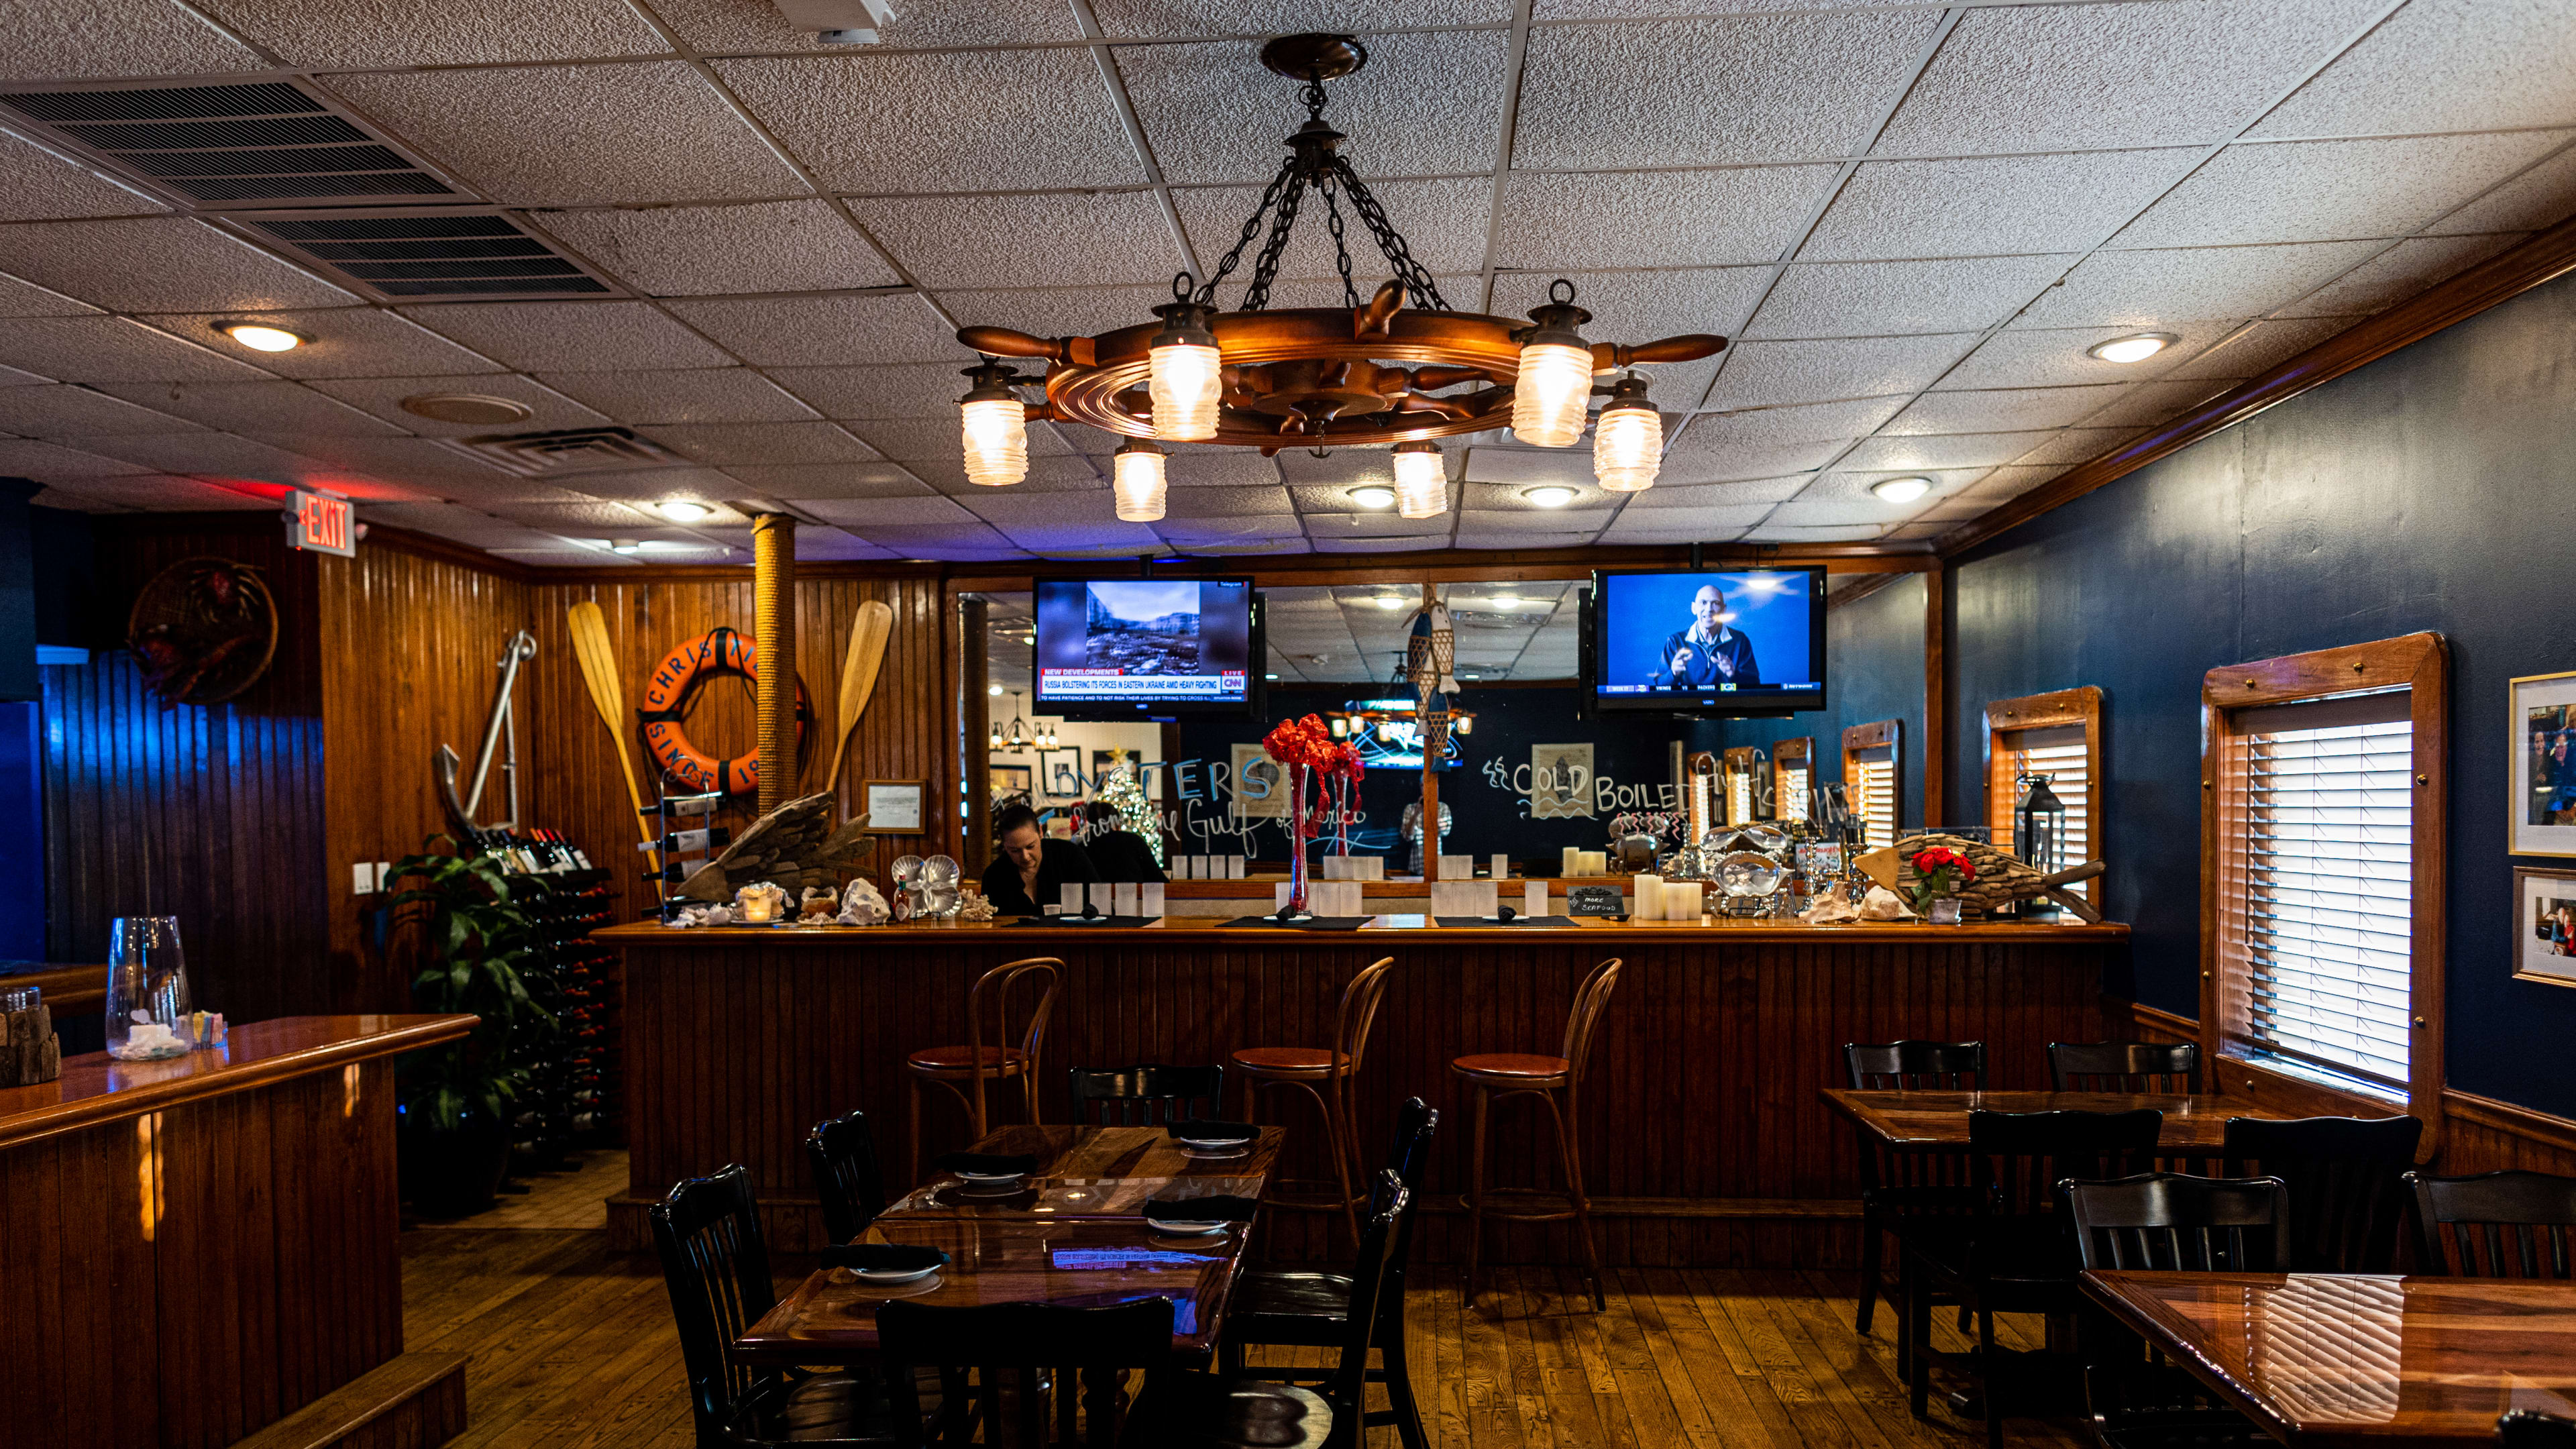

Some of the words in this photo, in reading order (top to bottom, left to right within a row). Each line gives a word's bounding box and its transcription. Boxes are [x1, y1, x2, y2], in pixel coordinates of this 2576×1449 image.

[306, 494, 347, 549] EXIT
[649, 638, 758, 704] CHRISTI
[1044, 680, 1061, 689] RUSSIA
[1062, 680, 1089, 689] BOLSTERING
[1099, 680, 1116, 689] FORCES
[1118, 680, 1122, 689] IN
[1124, 680, 1144, 689] EASTERN
[1145, 680, 1165, 689] UKRAINE
[1166, 680, 1178, 689] AMID
[1179, 680, 1194, 689] HEAVY
[1195, 680, 1217, 689] FIGHTING
[1224, 679, 1242, 687] CNN
[649, 724, 714, 786] SINCE
[1057, 757, 1272, 805] OYSTERS
[1513, 764, 1589, 796] COLD
[1596, 777, 1696, 812] BOILED
[1187, 798, 1271, 859] Gulf
